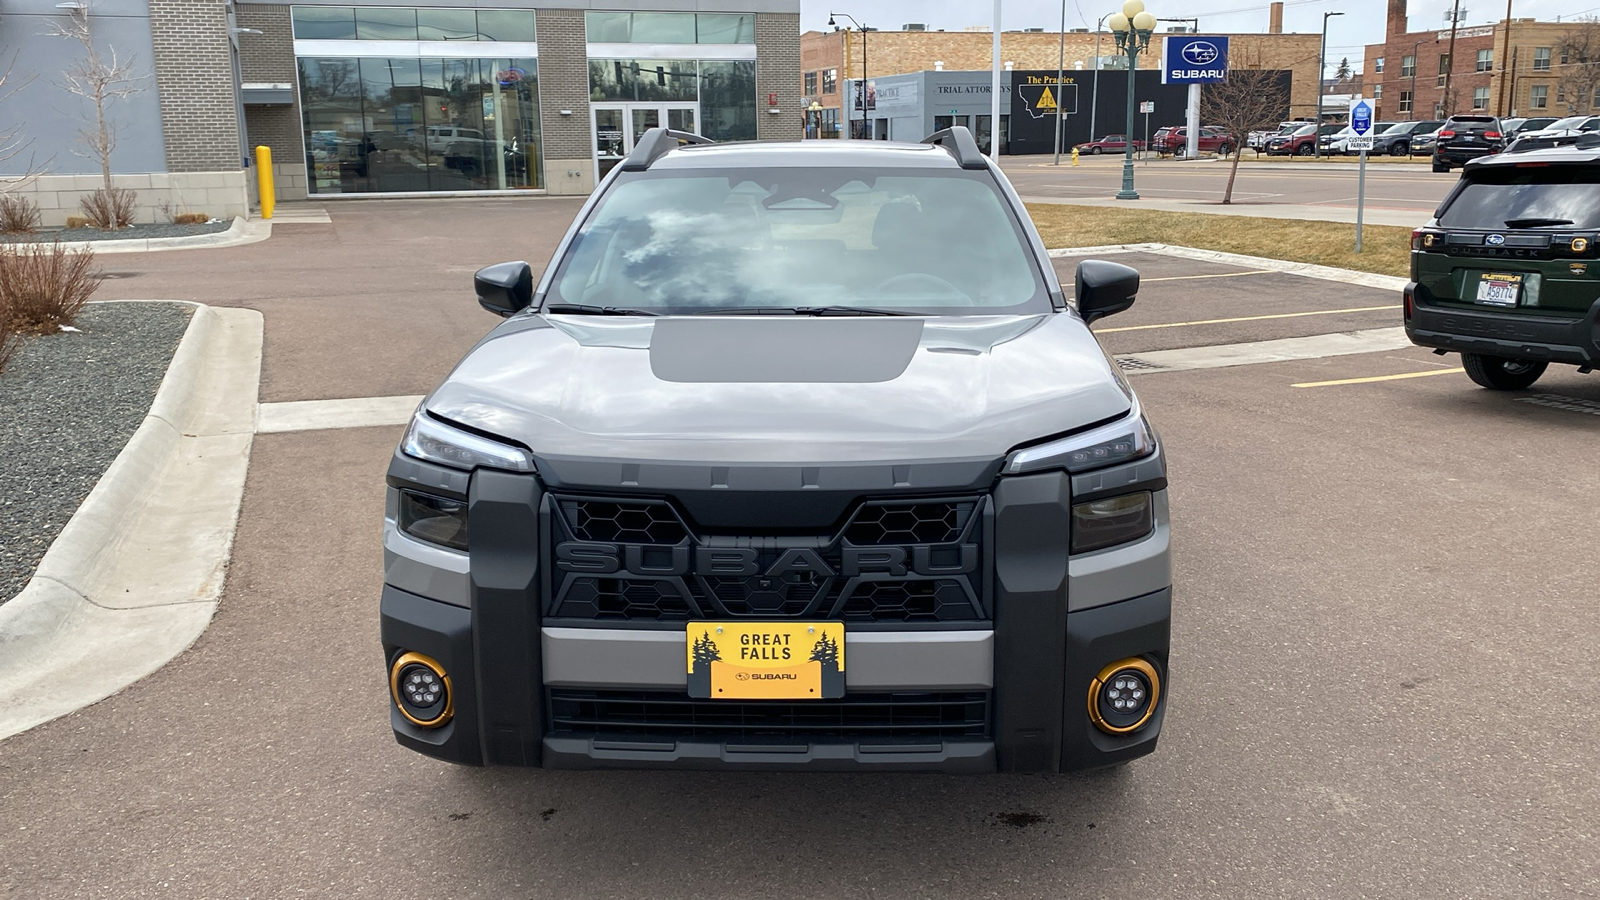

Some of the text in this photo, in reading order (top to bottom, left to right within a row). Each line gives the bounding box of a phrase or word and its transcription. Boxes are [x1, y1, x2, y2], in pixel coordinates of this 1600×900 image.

[1026, 75, 1042, 84] The
[1172, 70, 1224, 79] SUBARU
[938, 85, 1012, 94] TRIAL ATTORYS
[1451, 247, 1539, 257] OUTBACK
[555, 541, 979, 577] SUBARU
[740, 633, 792, 646] GREAT
[740, 647, 792, 660] FALLS
